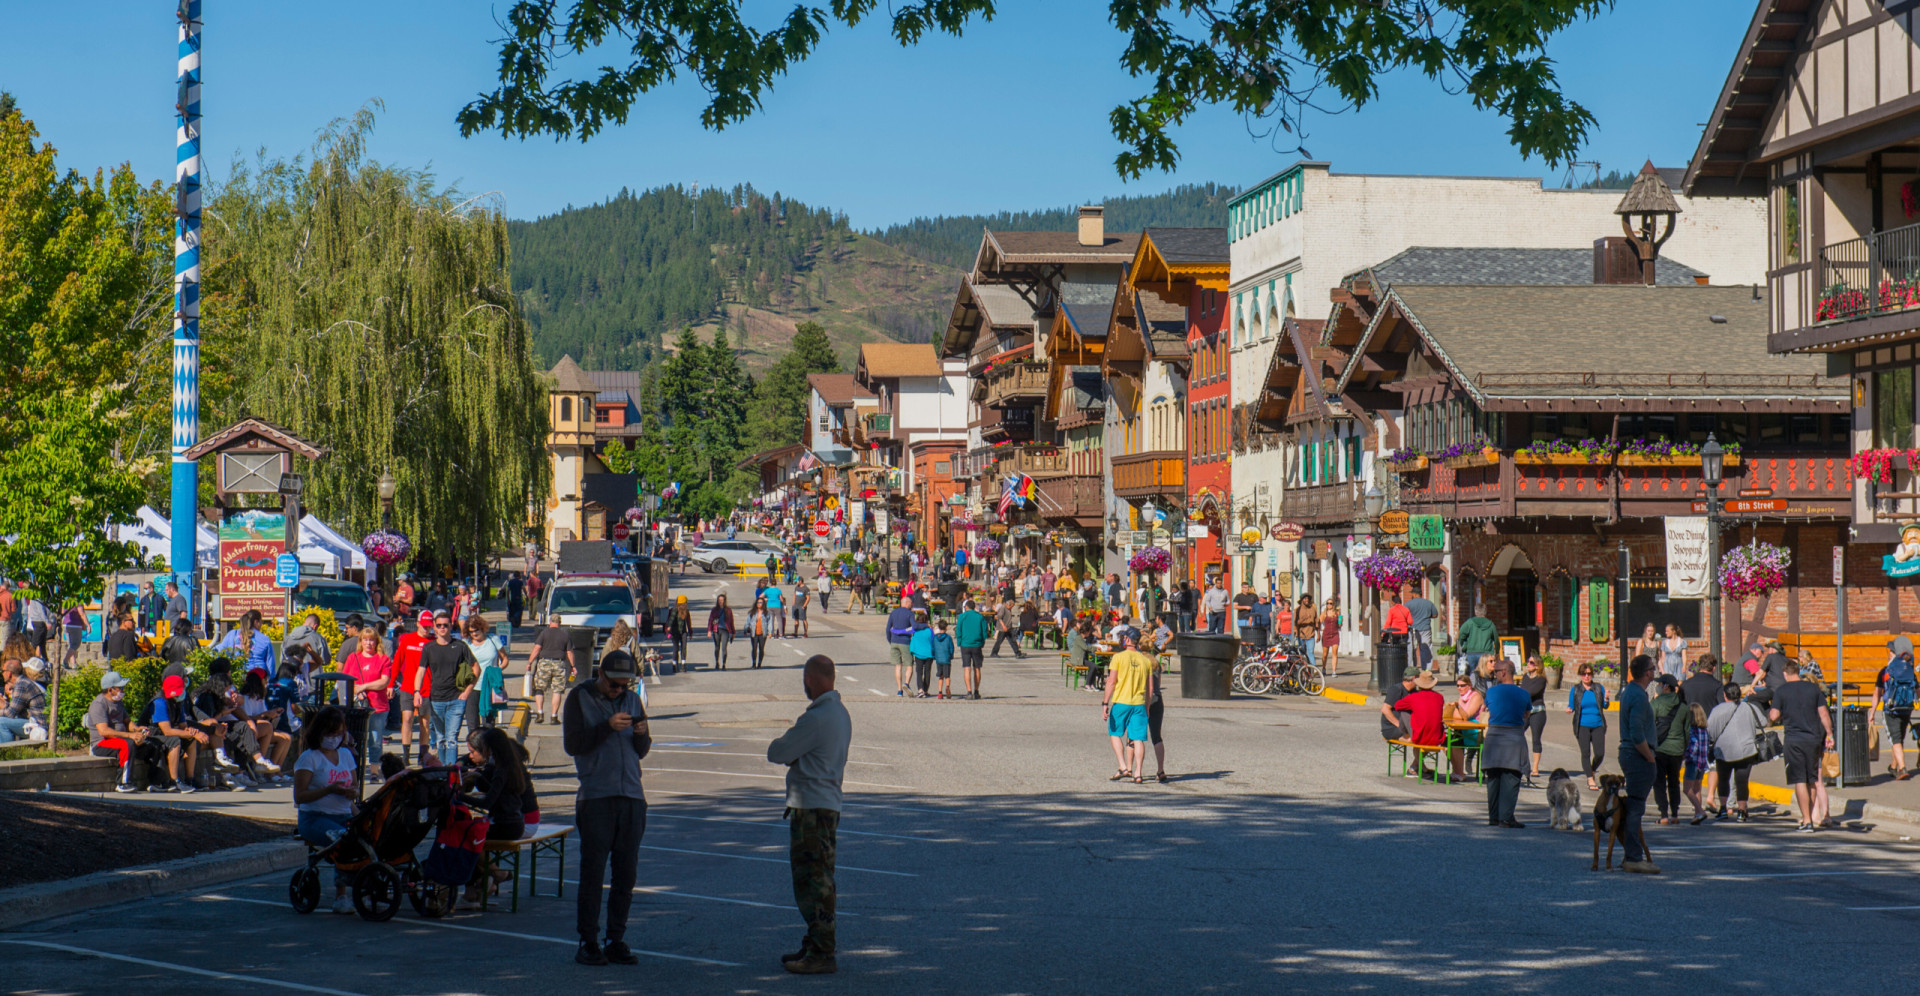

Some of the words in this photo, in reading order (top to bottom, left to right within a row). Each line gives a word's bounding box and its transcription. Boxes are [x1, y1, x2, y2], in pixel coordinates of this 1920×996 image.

[1738, 502, 1750, 510] 8th
[1753, 501, 1774, 510] Street
[1668, 529, 1684, 540] More
[1413, 537, 1440, 547] STEIN
[223, 542, 268, 563] Waterfront
[269, 546, 279, 557] Pa
[1674, 544, 1702, 557] Shopping
[1671, 560, 1682, 570] and
[1684, 560, 1706, 570] Services
[223, 566, 277, 577] Promena
[1594, 581, 1604, 638] STEIN
